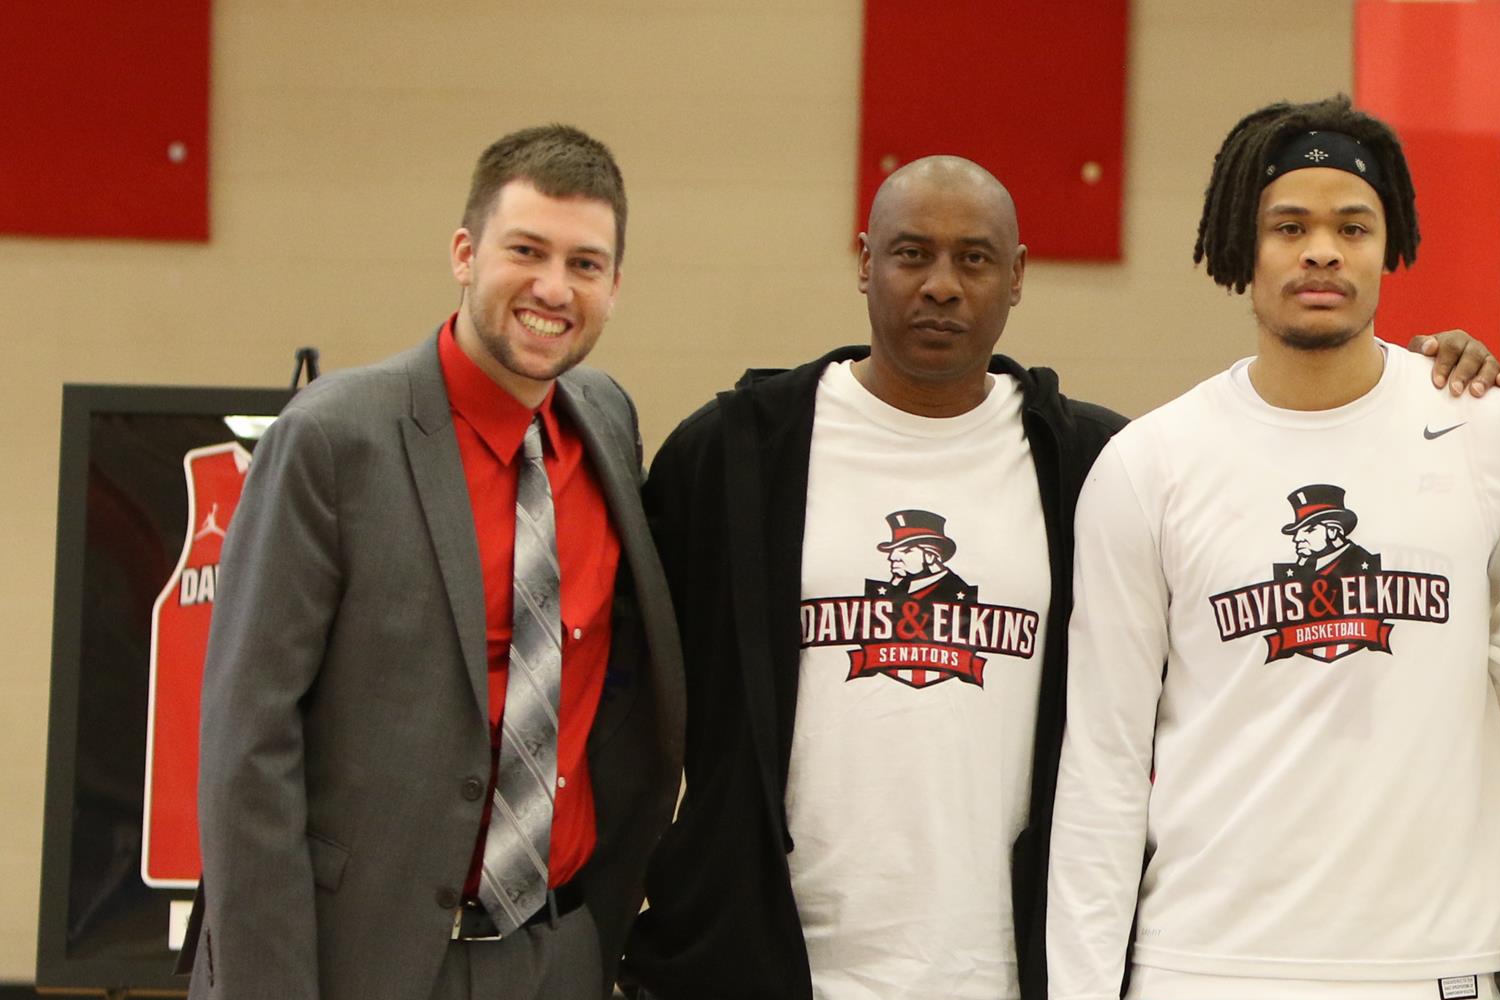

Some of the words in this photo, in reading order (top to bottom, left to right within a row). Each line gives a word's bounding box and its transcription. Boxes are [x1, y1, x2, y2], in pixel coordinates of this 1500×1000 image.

[1214, 582, 1304, 638] DAVIS
[1308, 579, 1339, 617] &
[1341, 575, 1448, 618] ELKINS
[800, 600, 893, 643] DAVIS
[896, 601, 929, 640] &
[933, 603, 1038, 654] ELKINS
[1295, 623, 1367, 643] BASKETBALL
[879, 647, 959, 666] SENATORS
